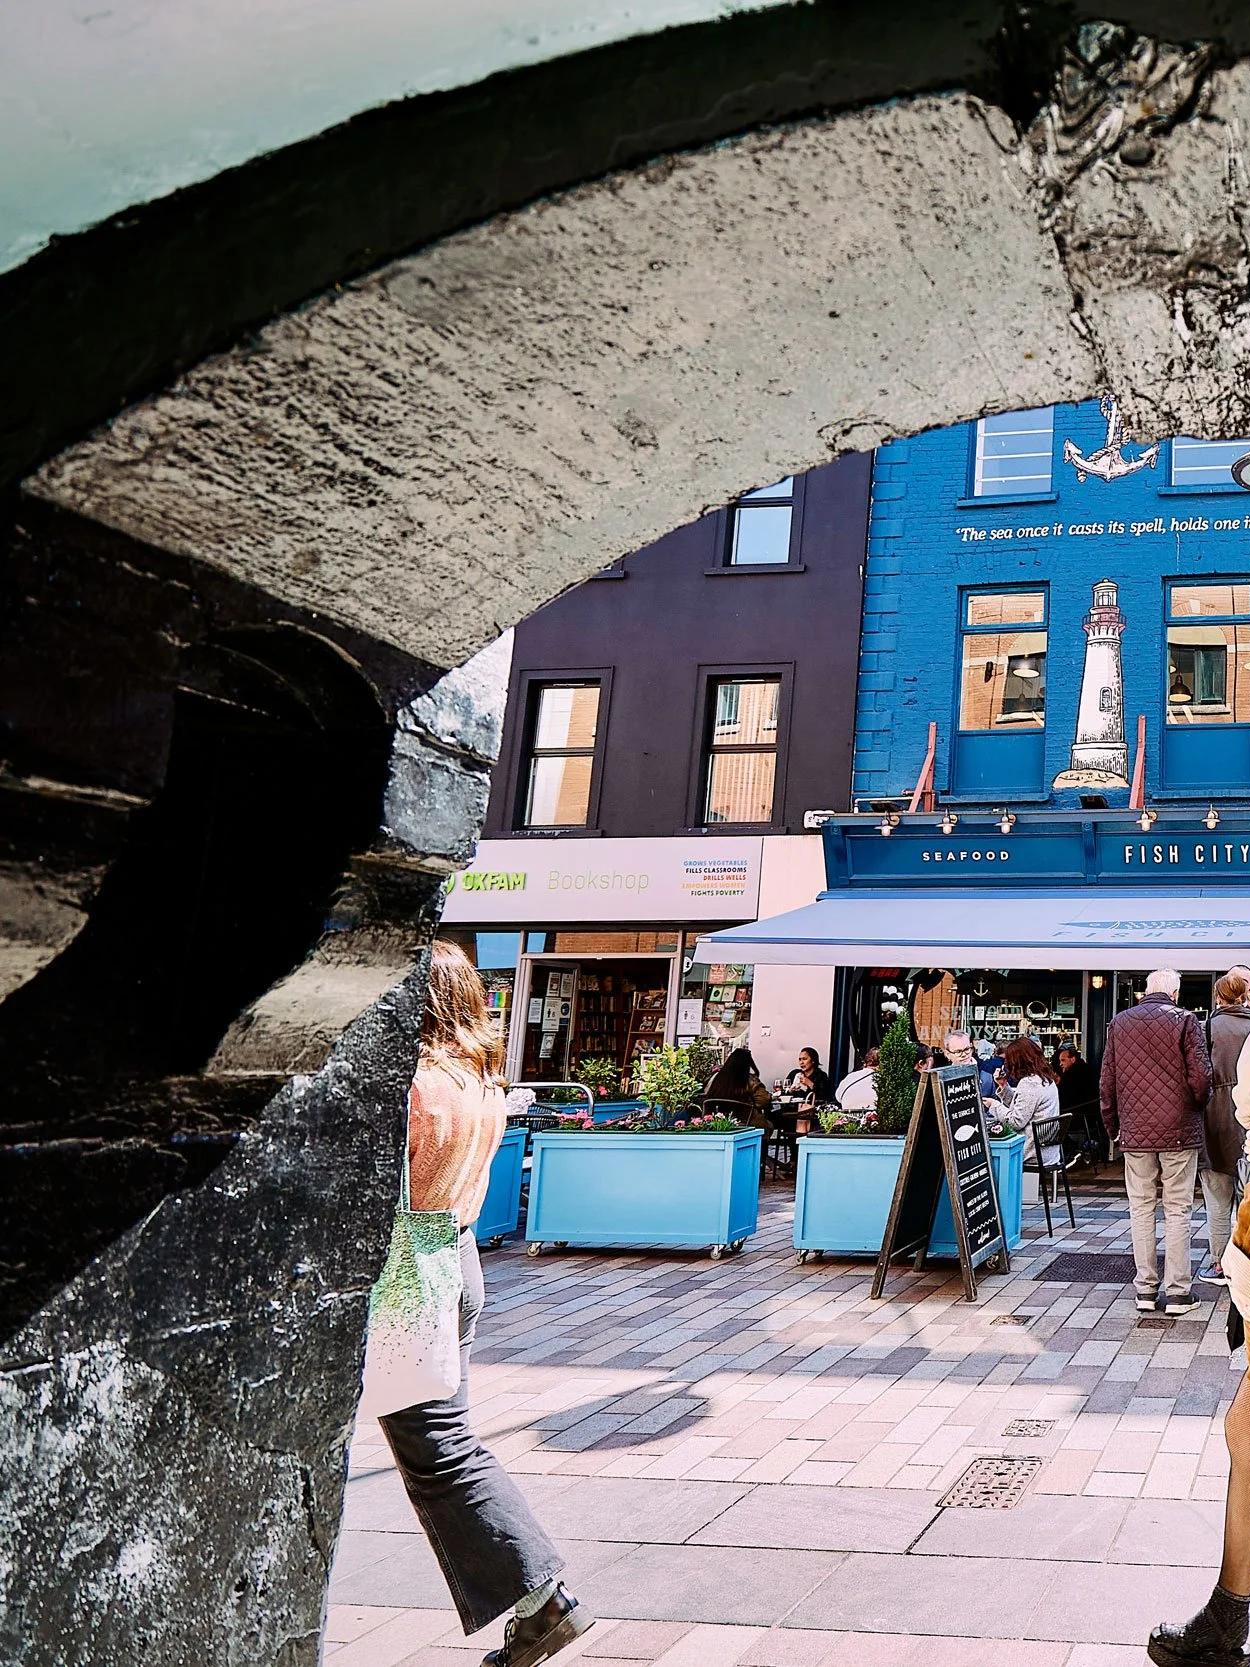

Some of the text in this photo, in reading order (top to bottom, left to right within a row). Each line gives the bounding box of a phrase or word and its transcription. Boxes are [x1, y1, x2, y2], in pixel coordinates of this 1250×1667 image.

[989, 528, 1013, 541] sea
[1016, 526, 1049, 539] once
[1053, 522, 1064, 536] it
[1069, 522, 1104, 536] casts
[1108, 520, 1125, 534] its
[1130, 518, 1167, 536] spell,
[1170, 517, 1209, 532] holds
[1213, 518, 1240, 531] one
[922, 850, 1010, 862] SEAFOOD
[1124, 844, 1250, 864] FISH CITY
[462, 870, 650, 895] OXFAM Bookshop
